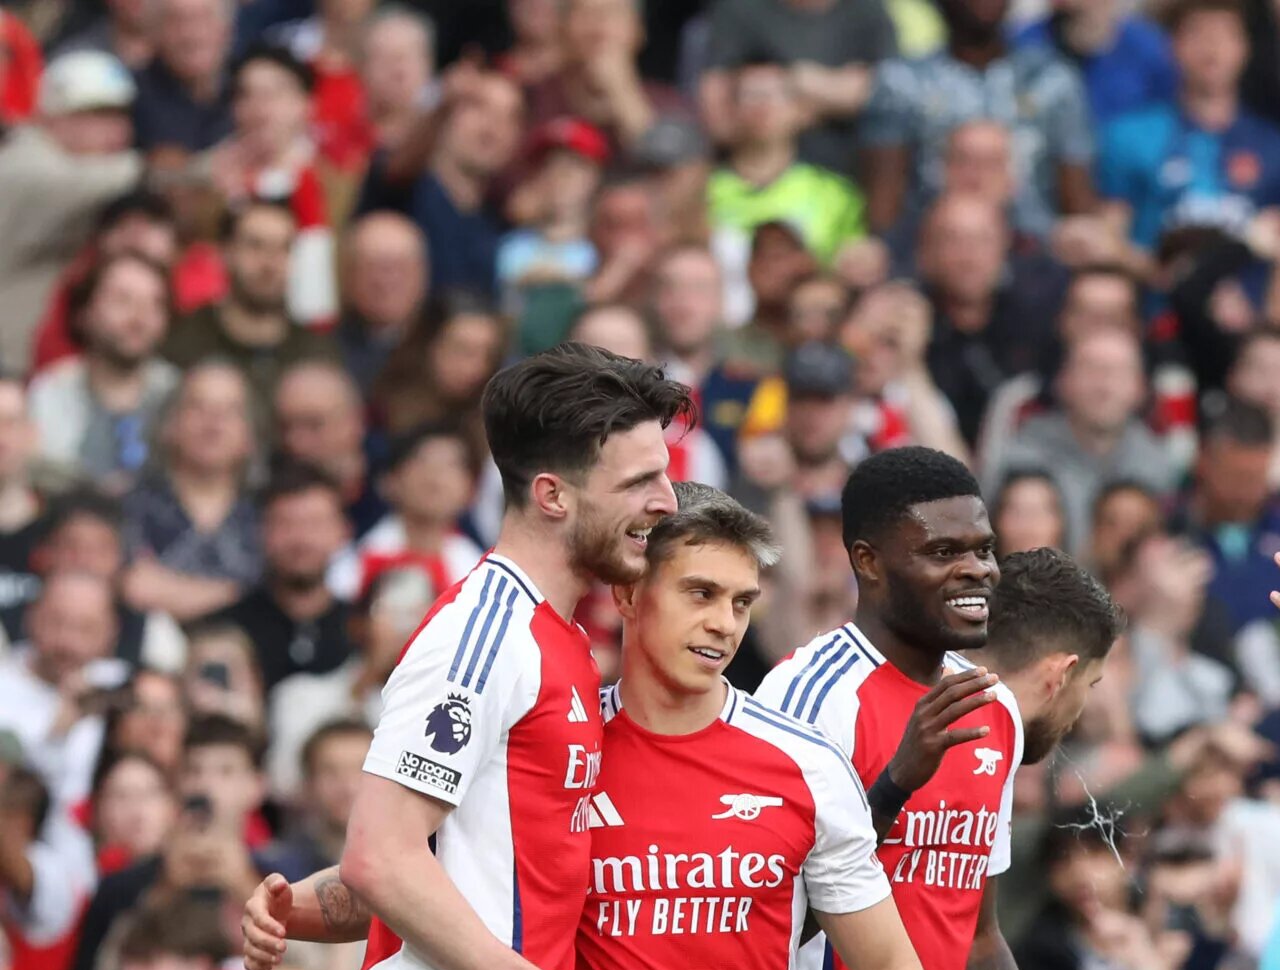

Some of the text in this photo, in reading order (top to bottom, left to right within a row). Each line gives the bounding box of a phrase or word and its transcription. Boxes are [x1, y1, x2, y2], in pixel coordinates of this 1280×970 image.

[400, 750, 456, 783] No room
[883, 800, 997, 847] mirate
[587, 844, 786, 895] mirates
[925, 848, 988, 890] BETTER
[652, 896, 752, 935] BETTER
